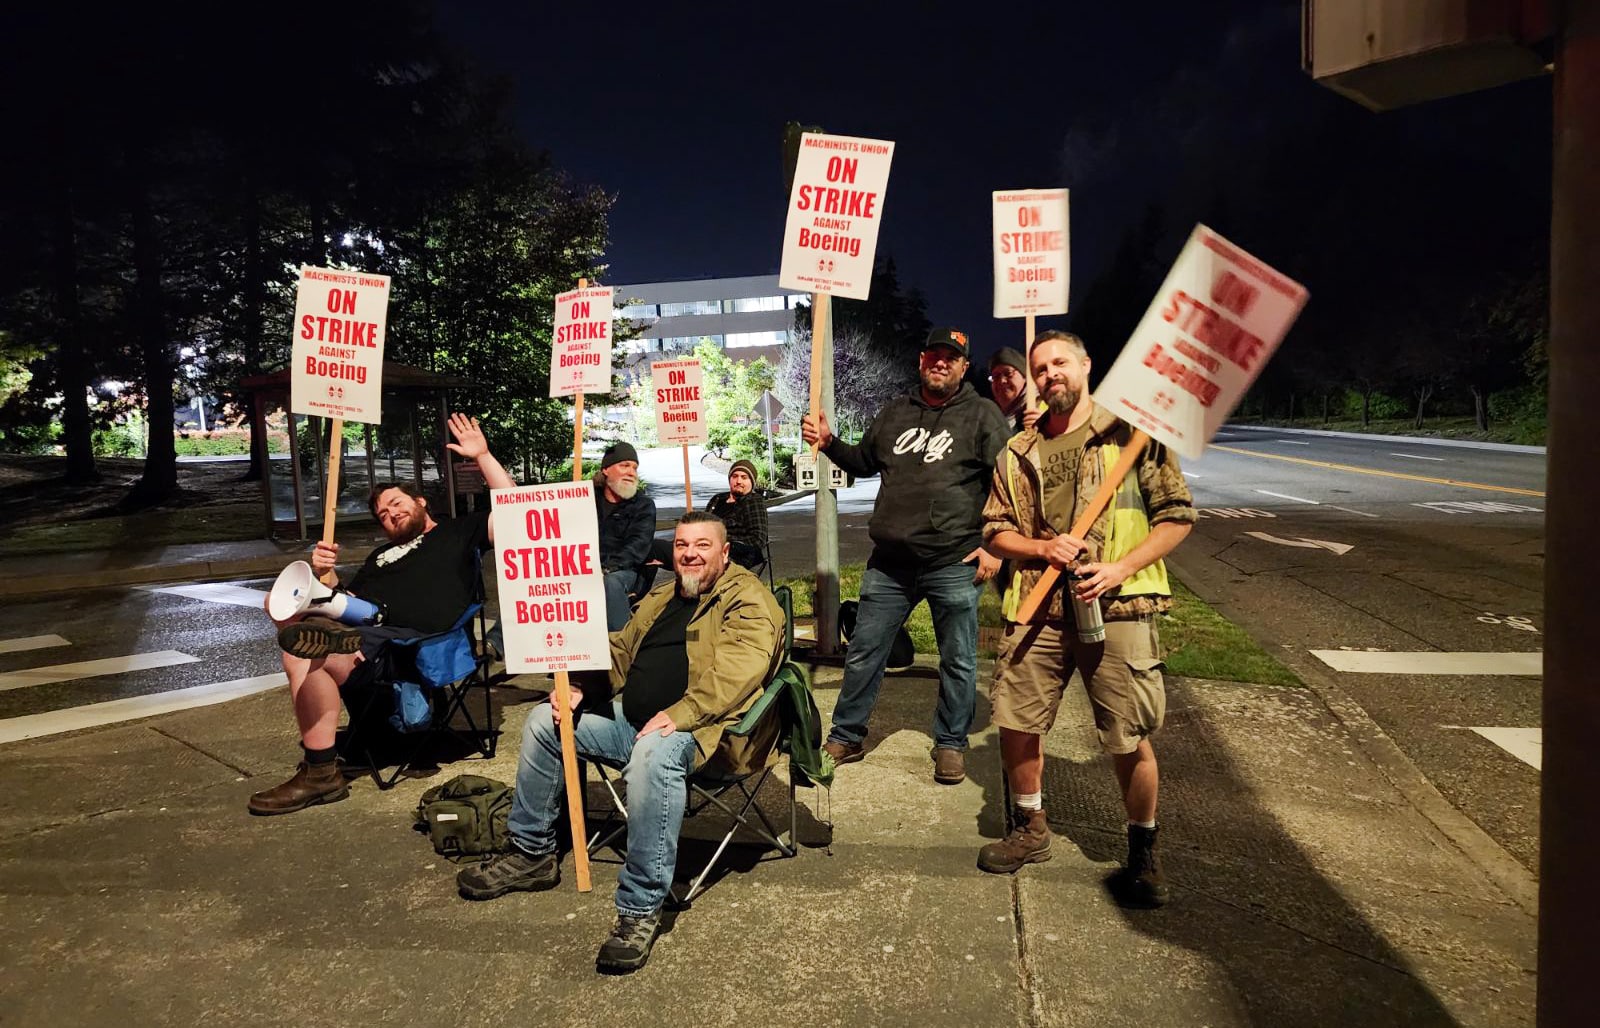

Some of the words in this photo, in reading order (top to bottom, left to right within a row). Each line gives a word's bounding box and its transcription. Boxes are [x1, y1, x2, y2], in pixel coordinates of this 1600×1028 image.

[804, 138, 858, 152] MACHINISTS
[861, 143, 889, 155] UNION
[826, 156, 858, 184] ON
[797, 184, 877, 219] STRIKE
[813, 217, 851, 231] AGAINST
[798, 227, 861, 257] Boeing
[304, 270, 357, 285] MACHINISTS
[359, 277, 386, 289] UNION
[327, 288, 357, 315] ON
[571, 301, 590, 320] ON
[301, 314, 378, 348] STRIKE
[557, 321, 607, 344] STRIKE
[318, 345, 356, 360] AGAINST
[568, 342, 592, 351] AGAINST
[560, 351, 601, 367] Boeing
[306, 356, 367, 384] Boeing
[668, 370, 686, 386] ON
[657, 386, 700, 404] STRIKE
[662, 410, 698, 423] Boeing
[496, 489, 555, 505] MACHINISTS
[557, 486, 589, 500] UNION
[525, 508, 561, 541] ON
[503, 543, 593, 581] STRIKE
[528, 582, 571, 597] AGAINST
[515, 598, 588, 624] Boeing
